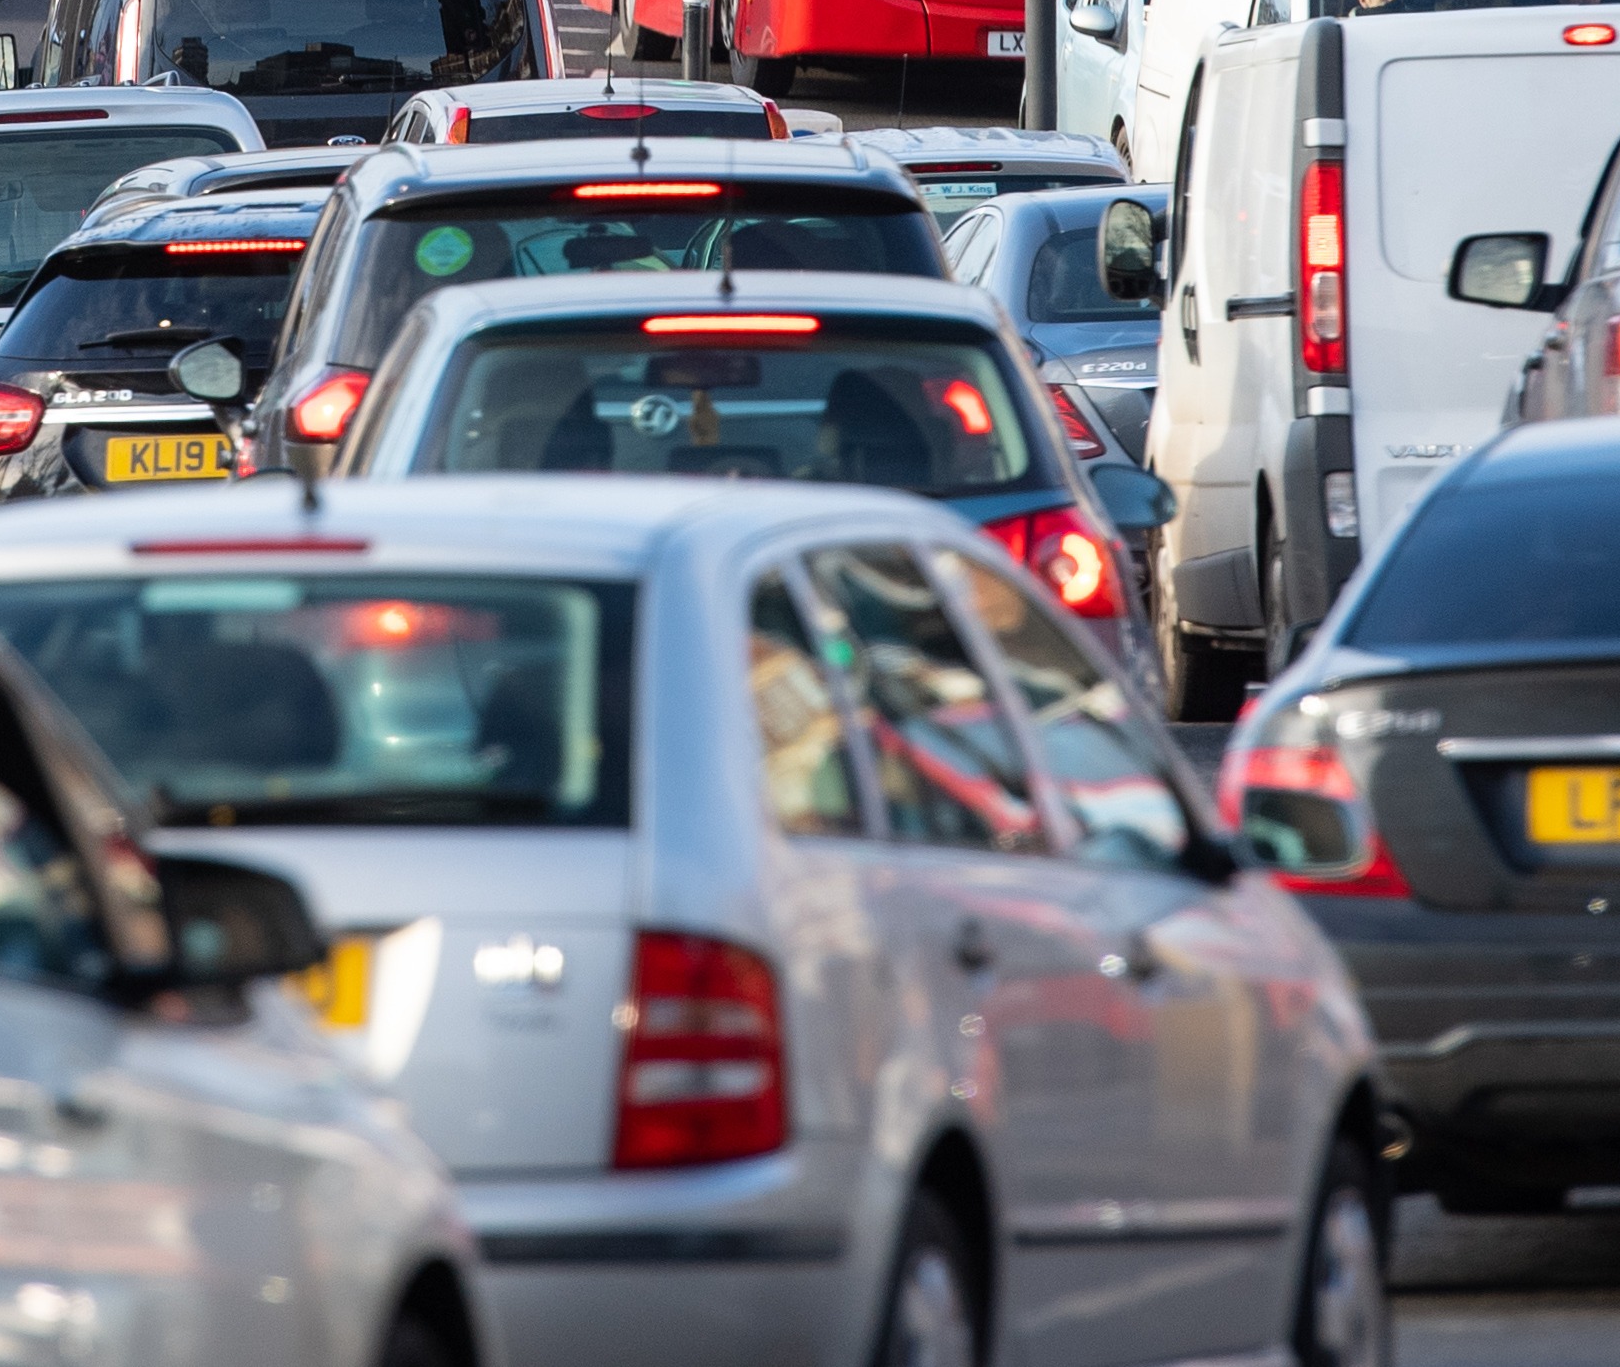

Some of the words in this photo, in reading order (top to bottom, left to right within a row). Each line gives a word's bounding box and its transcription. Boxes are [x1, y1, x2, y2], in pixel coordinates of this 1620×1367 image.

[968, 185, 993, 194] King
[53, 391, 91, 404] GLA
[130, 441, 205, 473] KL19
